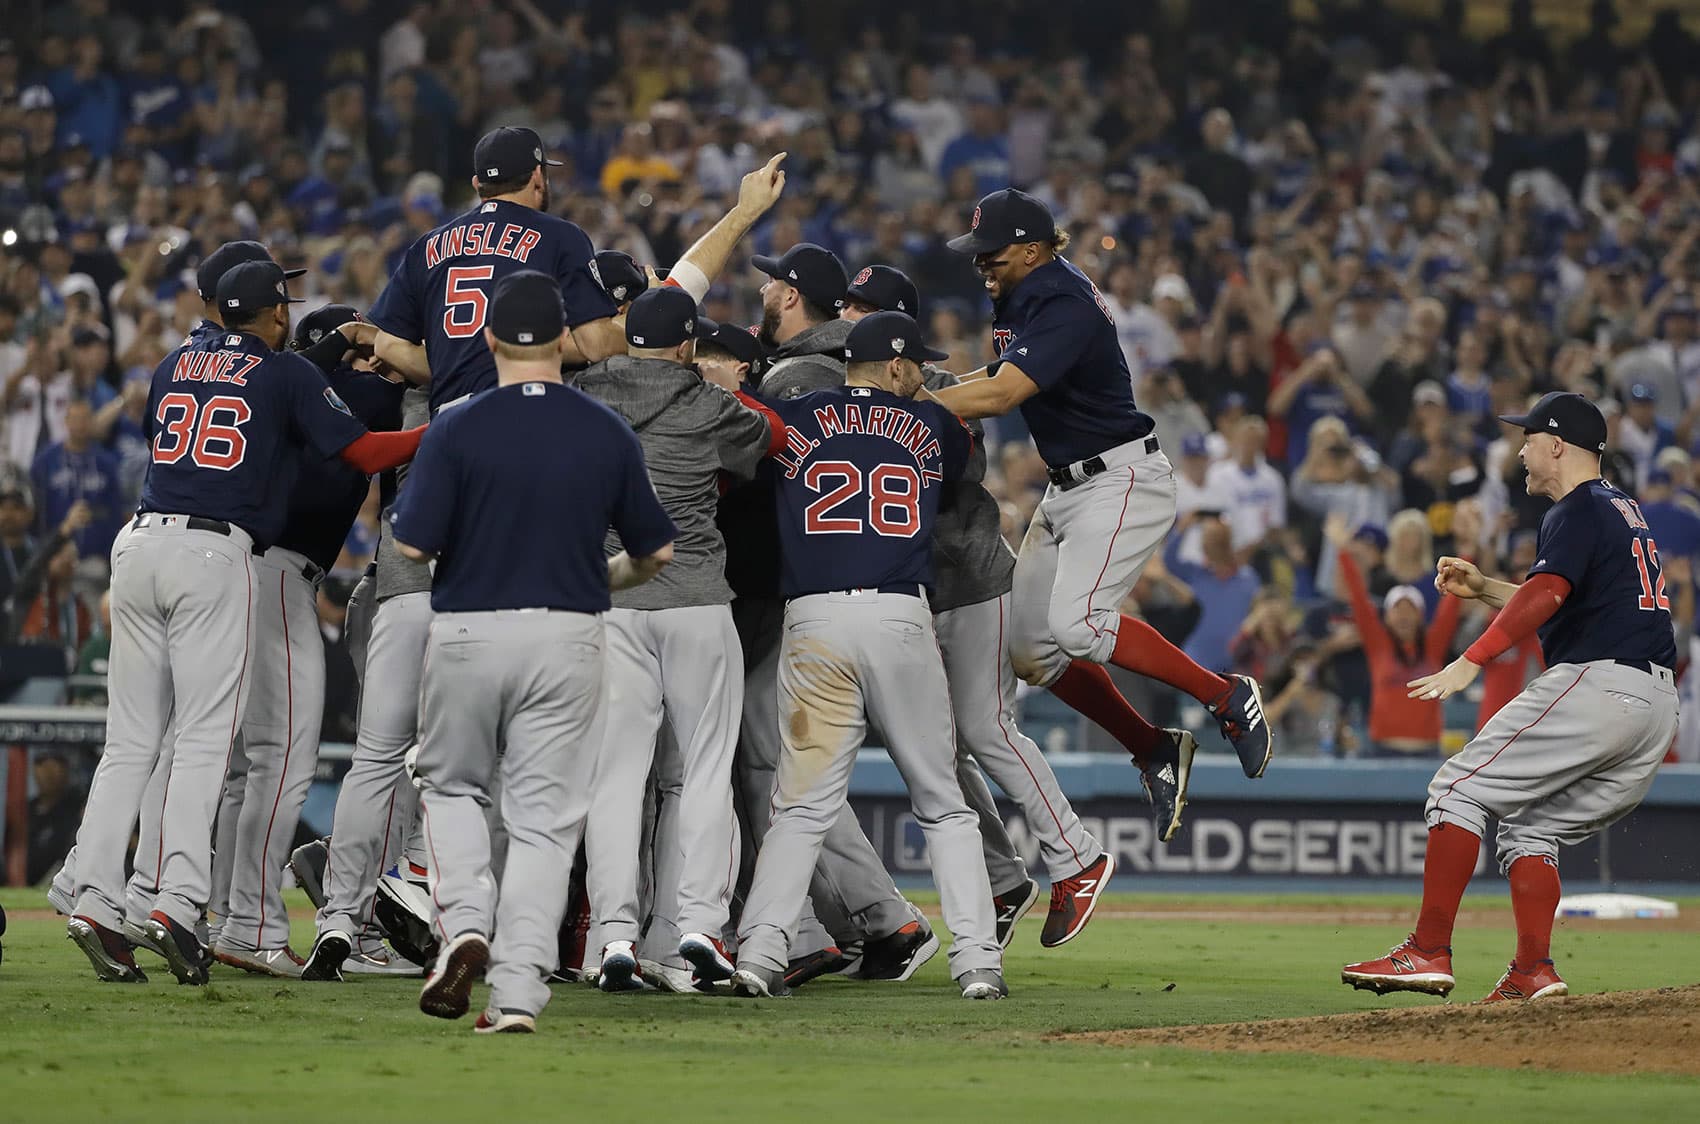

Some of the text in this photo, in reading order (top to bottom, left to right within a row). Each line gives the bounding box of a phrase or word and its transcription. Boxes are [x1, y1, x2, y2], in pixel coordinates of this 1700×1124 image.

[425, 222, 541, 269] KINSLER
[443, 265, 494, 338] 5
[152, 392, 252, 471] 36
[813, 404, 944, 489] MARTINEZ
[804, 460, 921, 538] 28
[1631, 537, 1671, 614] 12
[1003, 816, 1487, 875] WRLD SERIE
